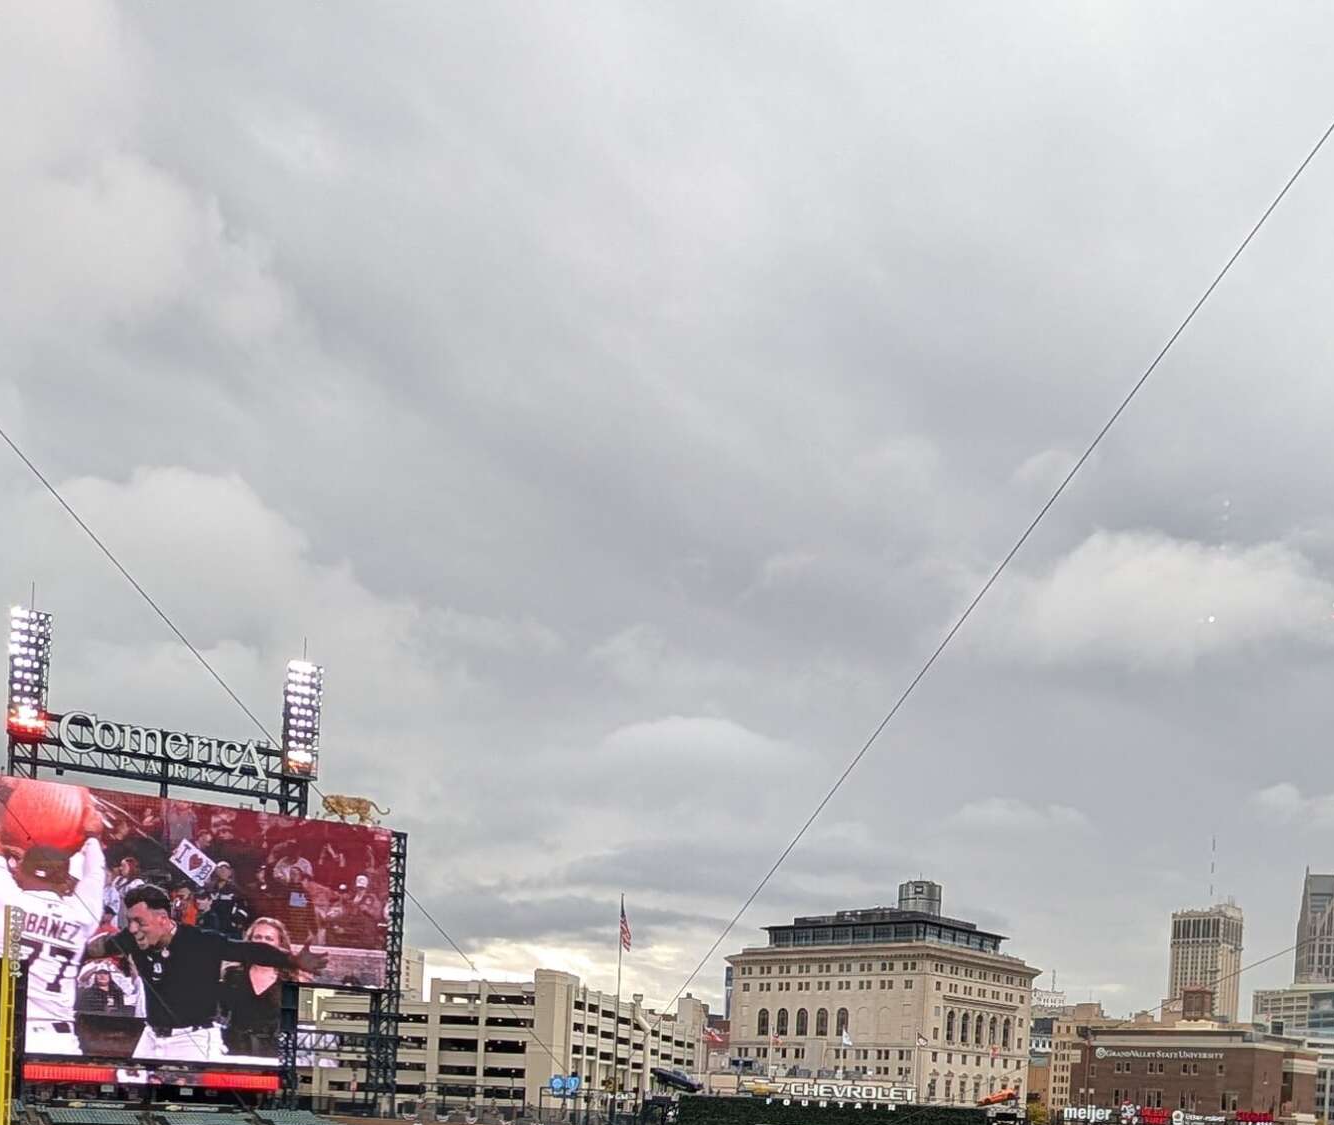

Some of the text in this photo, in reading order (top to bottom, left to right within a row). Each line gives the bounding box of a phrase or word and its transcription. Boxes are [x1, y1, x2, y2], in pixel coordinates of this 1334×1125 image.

[120, 756, 217, 782] PARK
[19, 938, 76, 993] 77
[791, 1082, 916, 1101] CHEVROLET
[765, 1098, 896, 1111] FOUNTAIN
[1064, 1106, 1112, 1123] meijer
